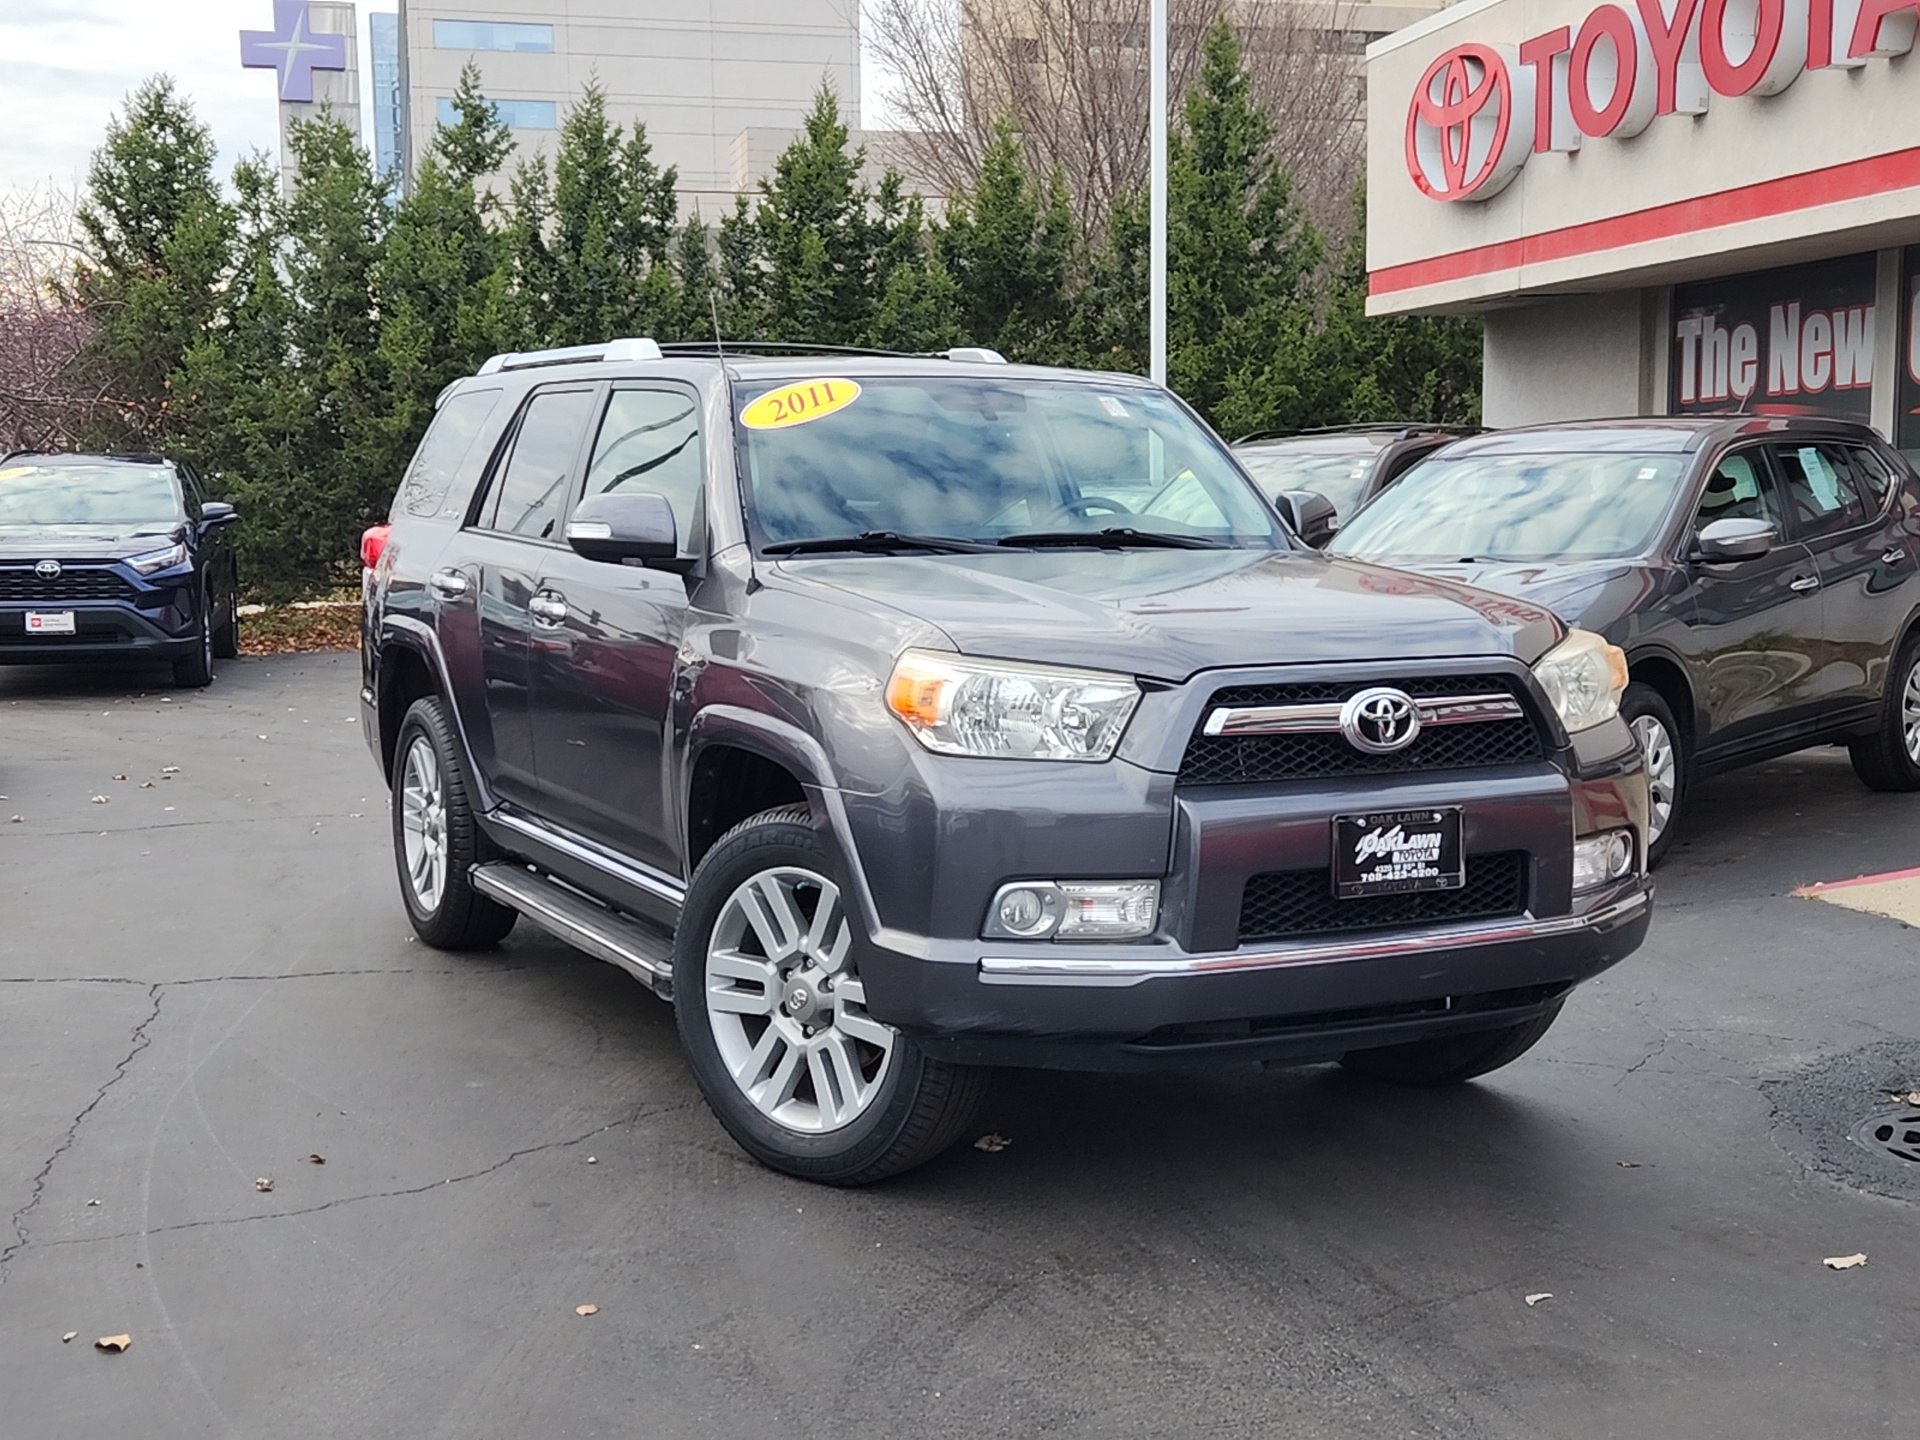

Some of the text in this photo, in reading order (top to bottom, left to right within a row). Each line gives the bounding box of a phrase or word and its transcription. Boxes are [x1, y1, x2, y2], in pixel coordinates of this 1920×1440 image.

[1677, 314, 1758, 403] The
[1767, 299, 1875, 396] New
[768, 383, 838, 422] 2011
[1370, 812, 1429, 824] OAK LAWN
[1398, 849, 1434, 861] TOYOTA
